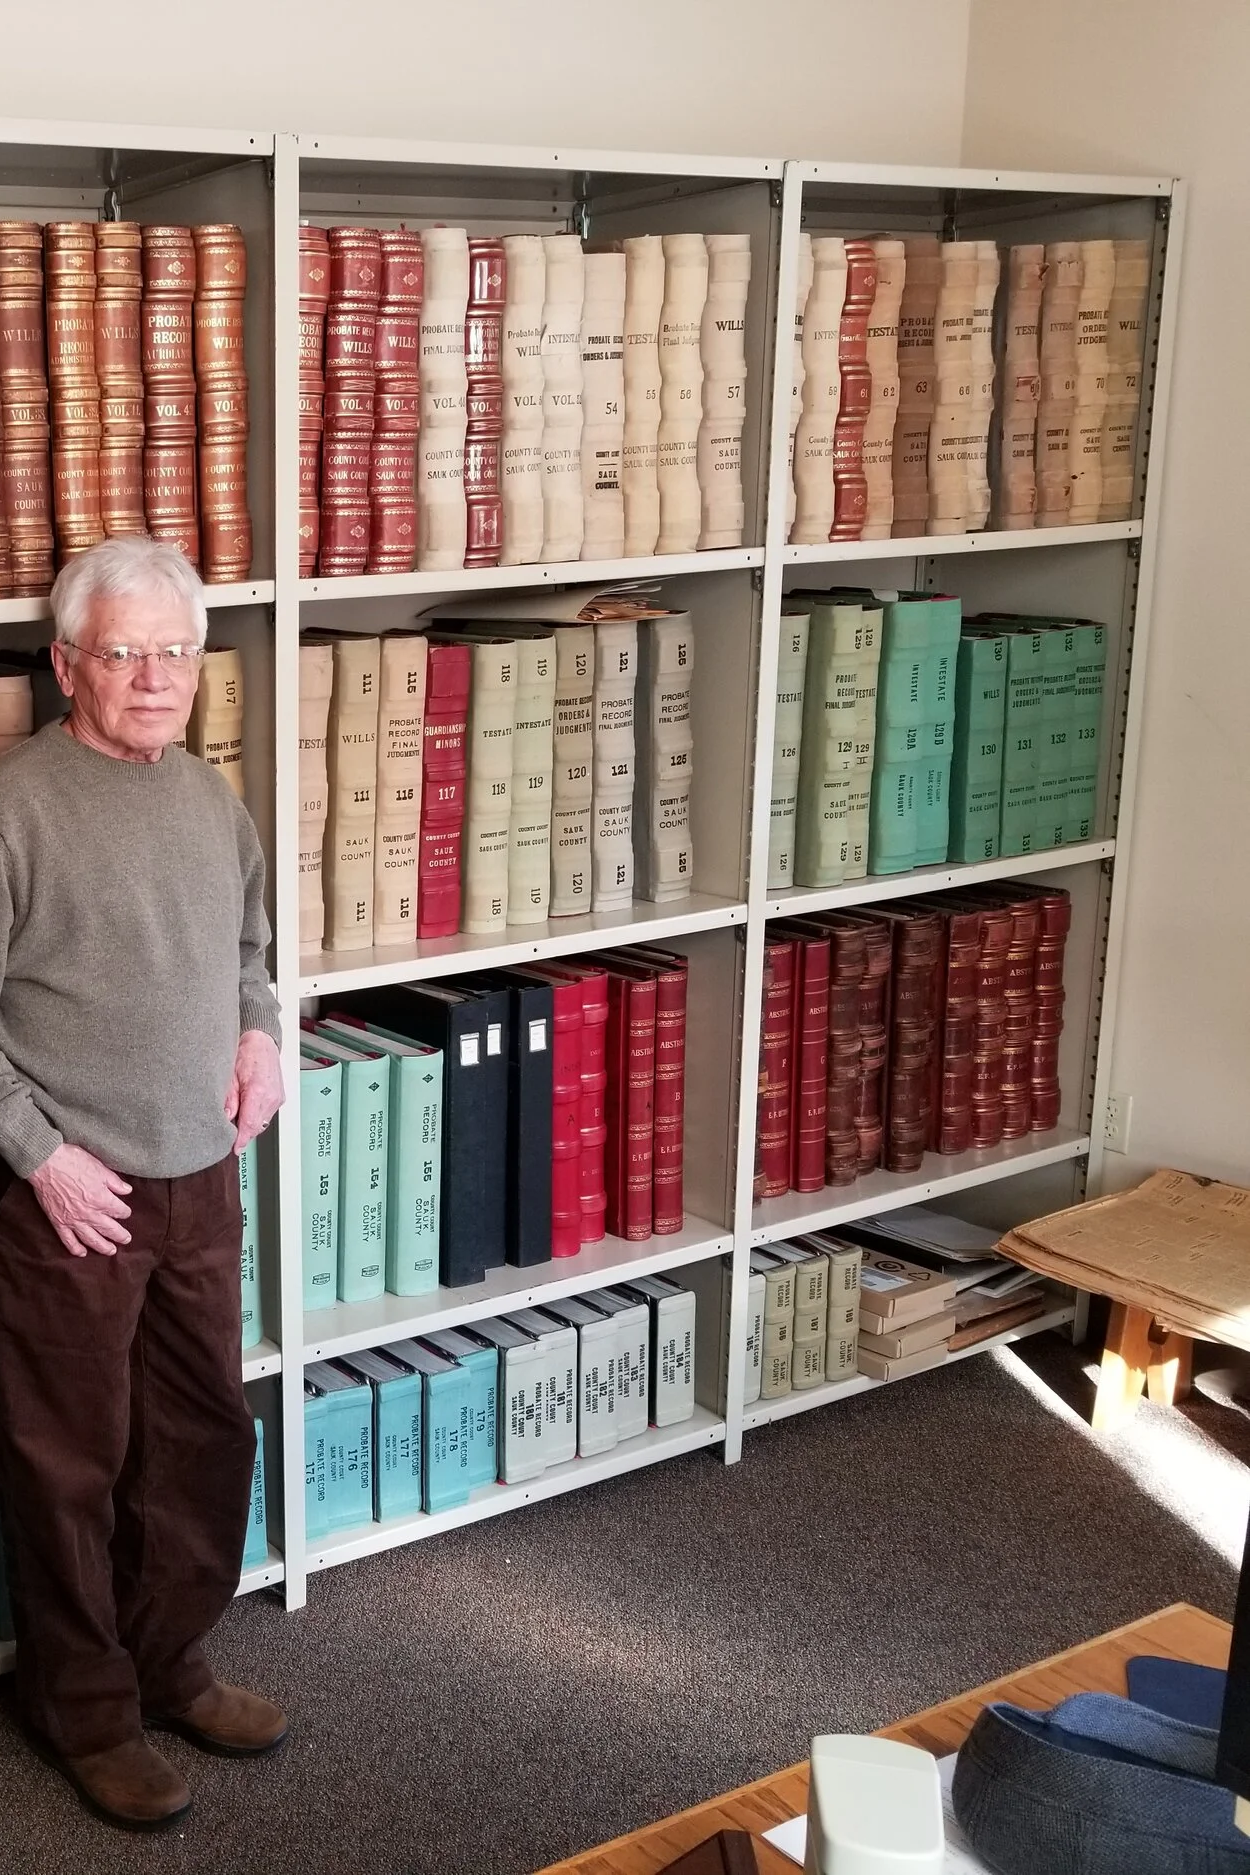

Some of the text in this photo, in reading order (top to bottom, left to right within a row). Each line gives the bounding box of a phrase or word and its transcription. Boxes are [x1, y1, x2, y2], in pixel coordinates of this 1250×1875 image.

[715, 320, 745, 331] WILLS
[341, 341, 373, 355] WILLS
[387, 335, 416, 349] WILLS
[915, 380, 928, 394] 63
[1125, 375, 1137, 388] 72
[645, 389, 657, 401] 55
[679, 388, 692, 400] 56
[727, 385, 740, 400] 57
[882, 387, 896, 397] 62
[605, 401, 618, 416] 54
[937, 657, 948, 703] INTESTATE
[983, 689, 1000, 700] WILLS
[601, 698, 633, 709] PROBATE
[602, 709, 633, 721] RECORD
[389, 717, 422, 727] PROBATE
[342, 732, 376, 745] WILLS
[388, 728, 420, 738] RECORD
[1050, 733, 1066, 745] 132
[1078, 728, 1096, 740] 133
[392, 740, 418, 749] FINAL
[837, 741, 853, 754] 129
[981, 743, 997, 756] 130
[781, 747, 797, 758] 126
[670, 754, 688, 766] 125
[567, 766, 588, 781] 120
[611, 764, 629, 777] 121
[492, 782, 506, 796] 118
[528, 776, 544, 789] 119
[353, 790, 370, 803] 111
[396, 789, 414, 801] 115
[438, 786, 456, 801] 117
[664, 807, 687, 817] SAUK
[599, 827, 631, 838] COUNTY
[346, 837, 370, 847] SAUK
[340, 851, 372, 861] COUNTY
[388, 846, 412, 856] SAUK
[384, 858, 416, 869] COUNTY
[317, 1119, 326, 1158] RECORD
[422, 1160, 432, 1182] 155
[319, 1174, 329, 1196] 153
[370, 1167, 379, 1190] 154
[675, 1352, 684, 1368] 184
[630, 1365, 639, 1382] 183
[476, 1409, 486, 1432] 179
[449, 1429, 459, 1453] 178
[400, 1437, 410, 1459] 177
[347, 1449, 359, 1472] 176
[305, 1461, 315, 1485] 175
